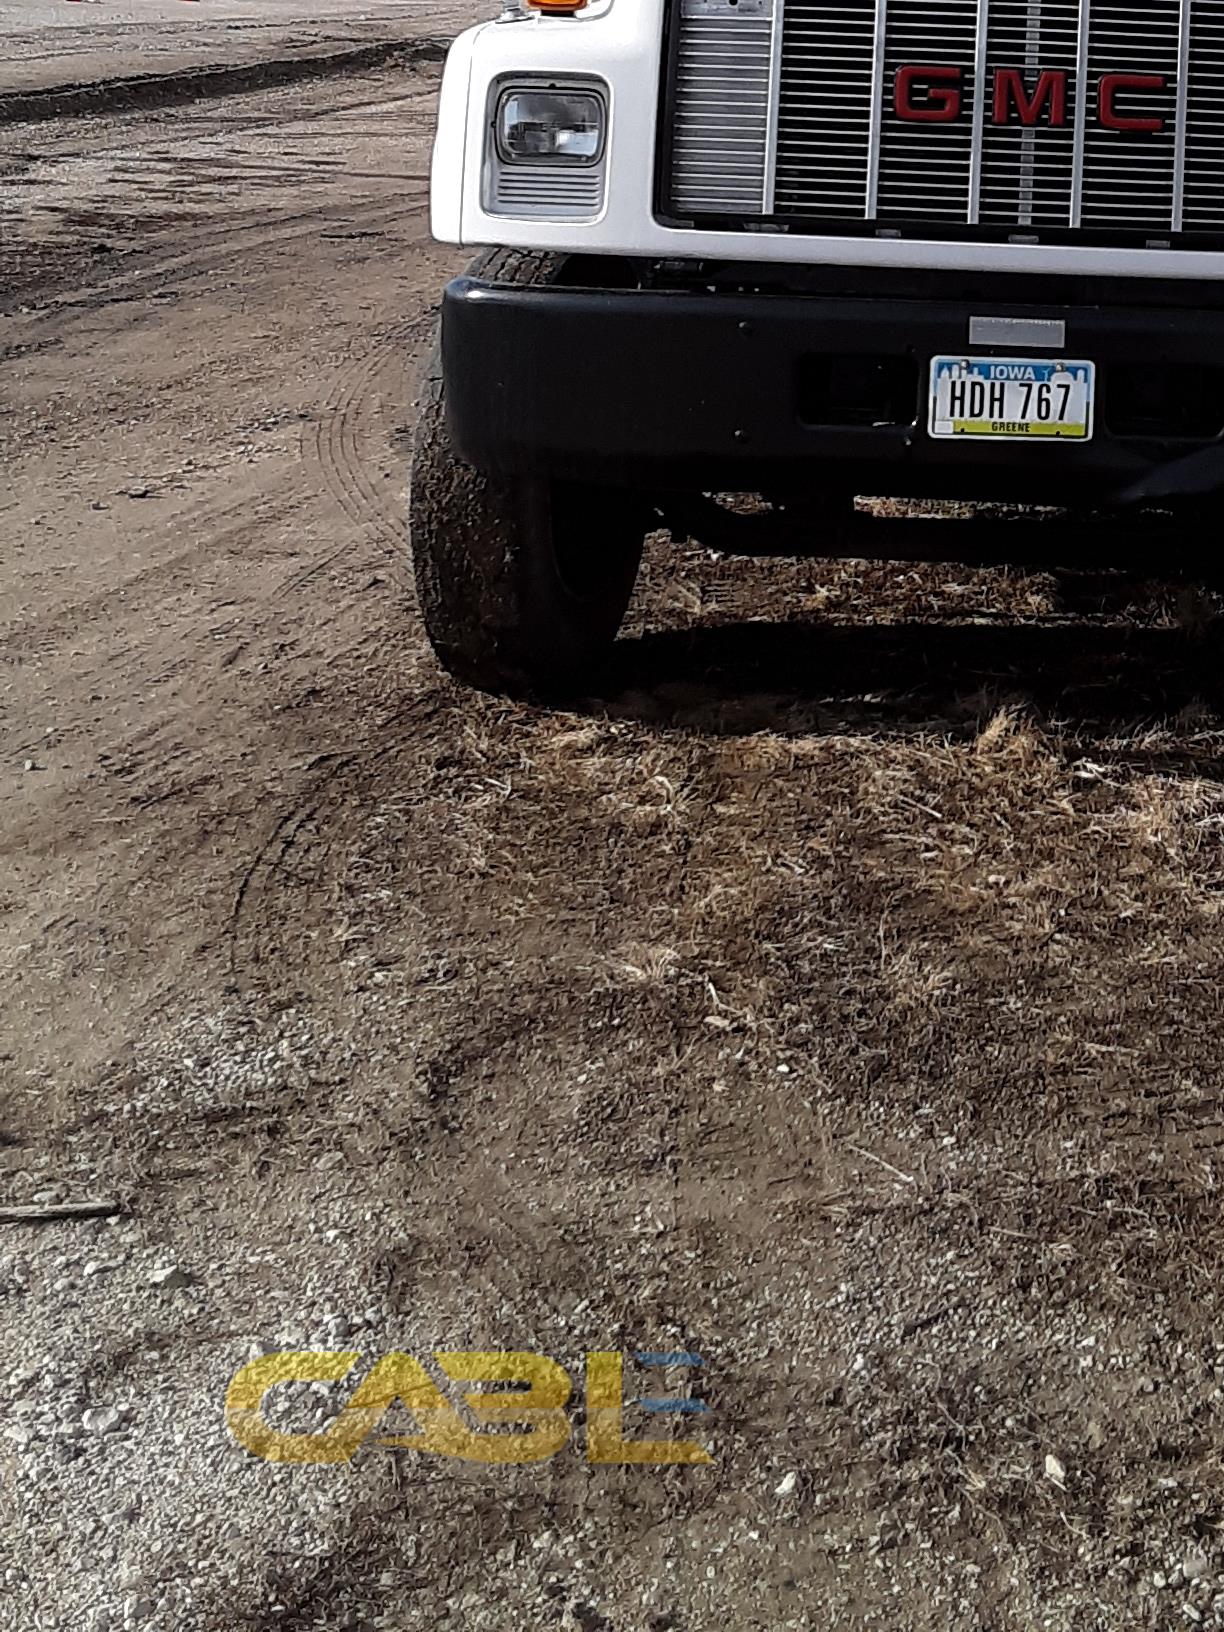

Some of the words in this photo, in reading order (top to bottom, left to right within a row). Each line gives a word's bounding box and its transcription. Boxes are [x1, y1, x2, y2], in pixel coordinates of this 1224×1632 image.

[893, 66, 1165, 133] GMC
[990, 365, 1036, 380] IOWA
[950, 380, 1006, 419] HDH
[1019, 382, 1071, 421] 767
[991, 421, 1031, 433] GREENE
